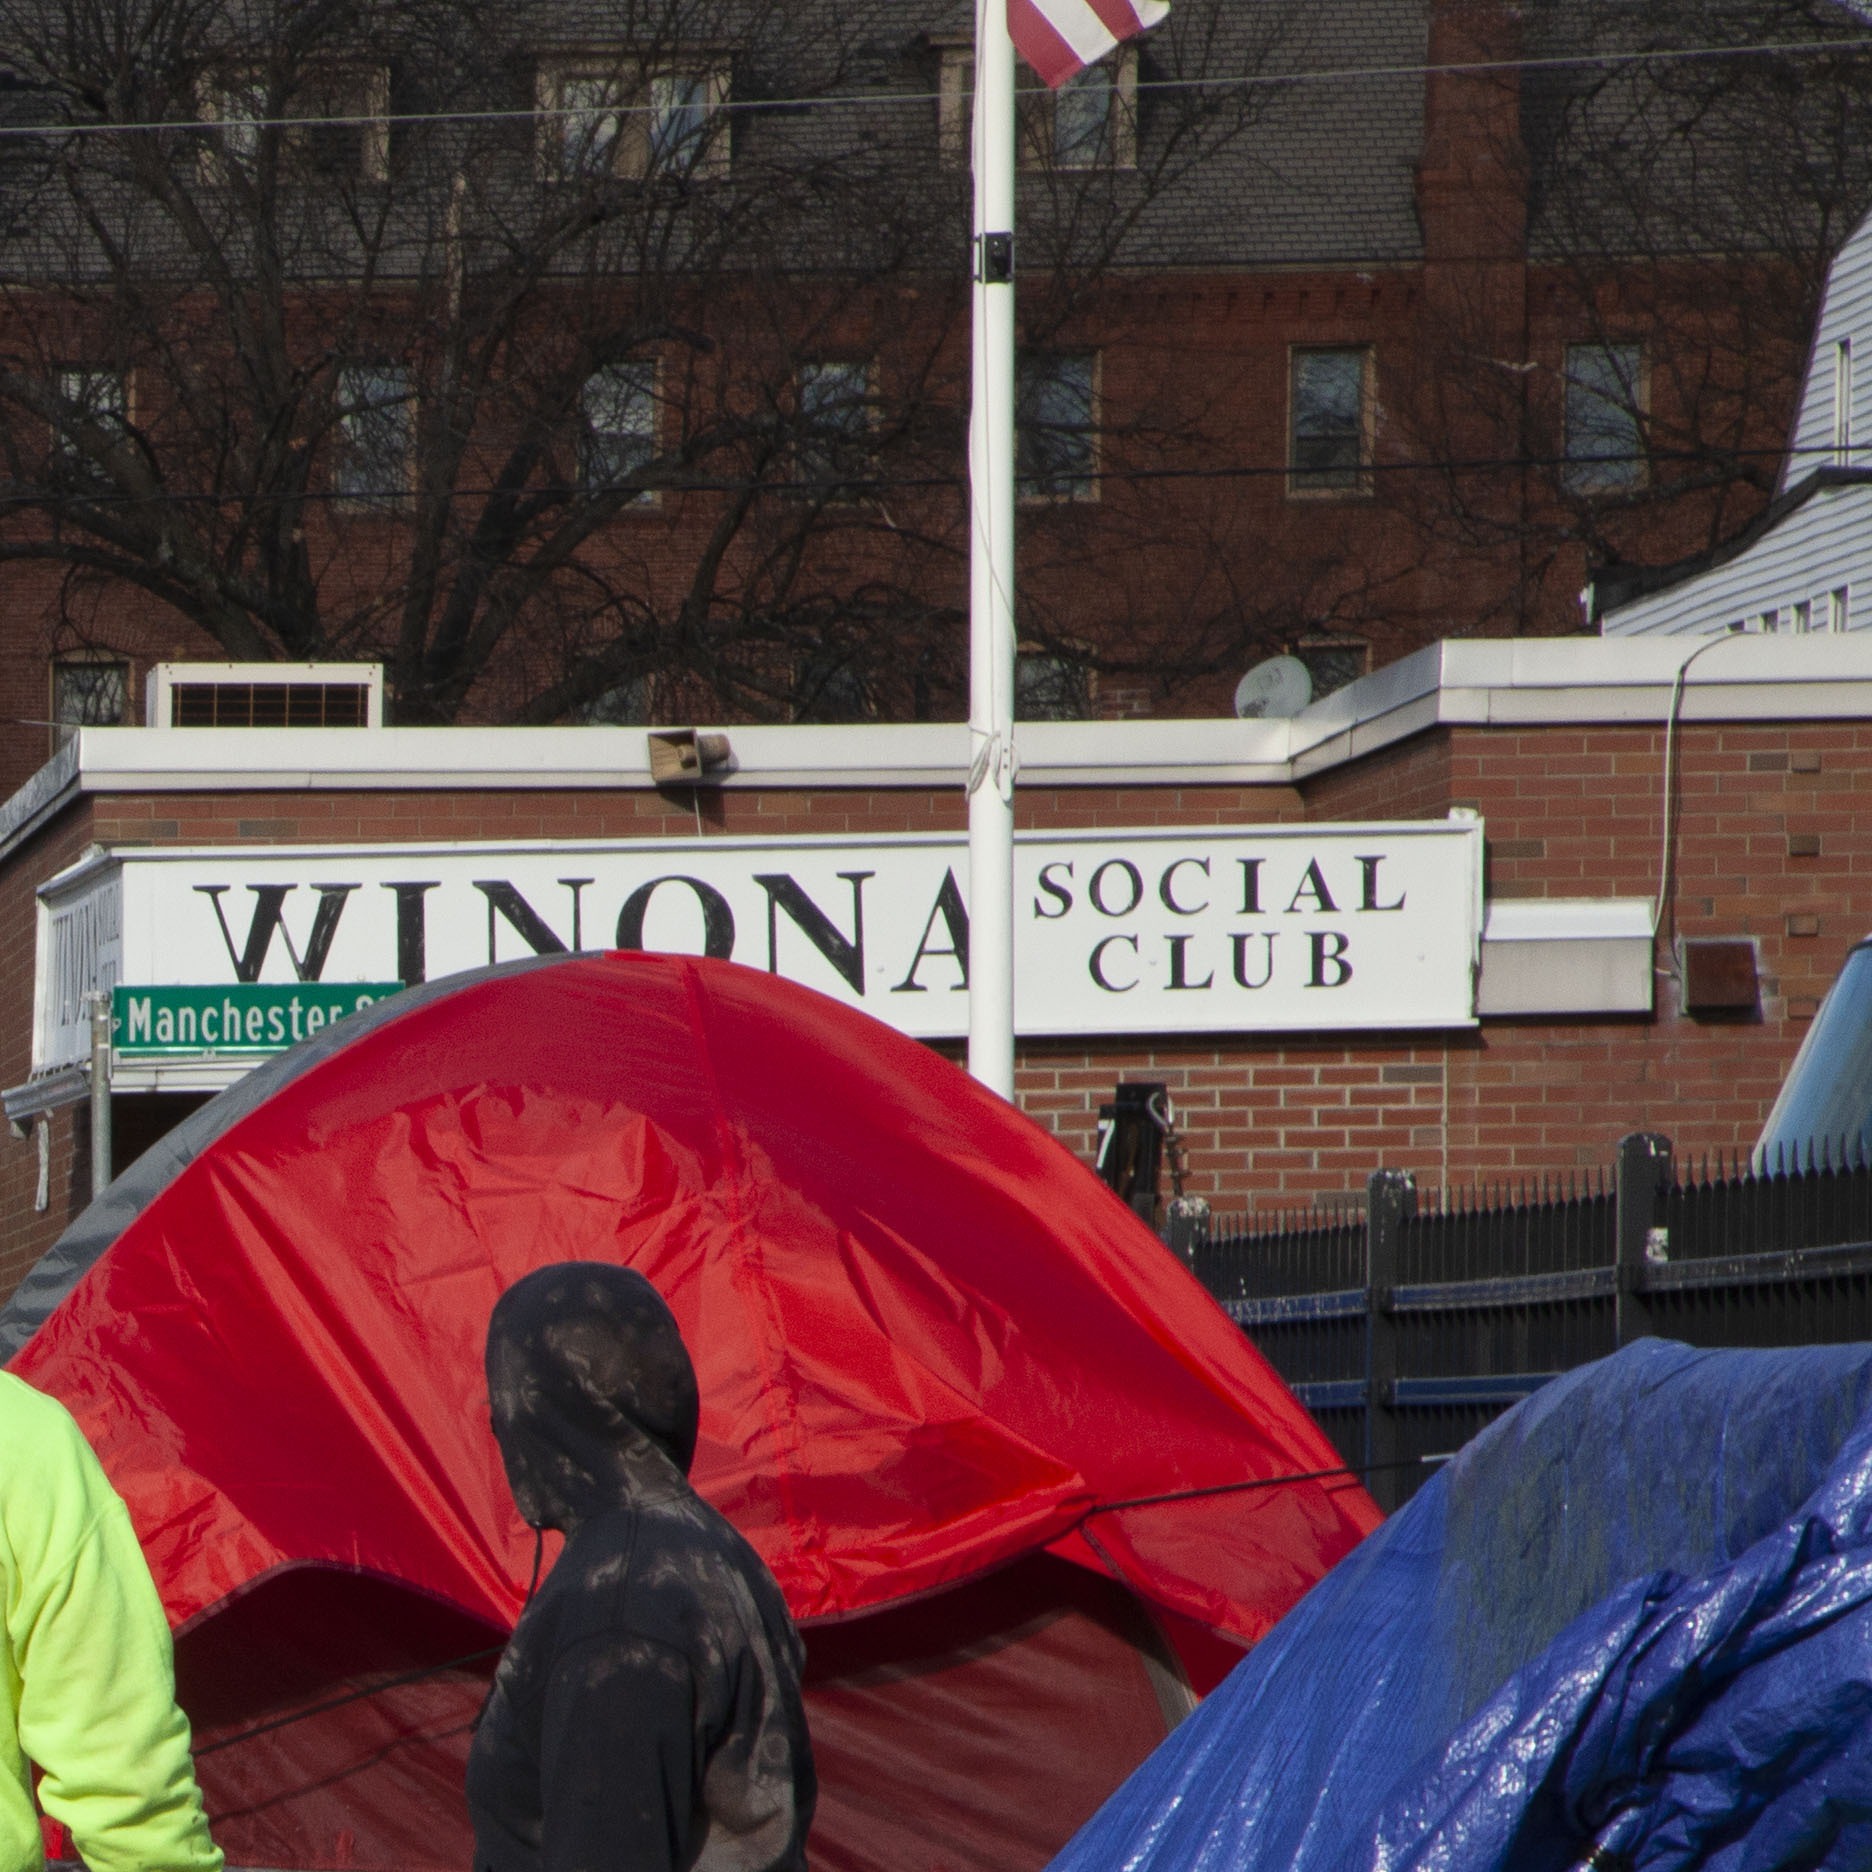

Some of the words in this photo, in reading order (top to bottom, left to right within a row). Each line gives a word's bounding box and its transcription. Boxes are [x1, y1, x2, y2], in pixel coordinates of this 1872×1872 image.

[192, 866, 970, 997] WINONA
[1033, 855, 1407, 920] SOCIAL
[1088, 932, 1354, 992] CLUB
[128, 997, 343, 1043] Manchester
